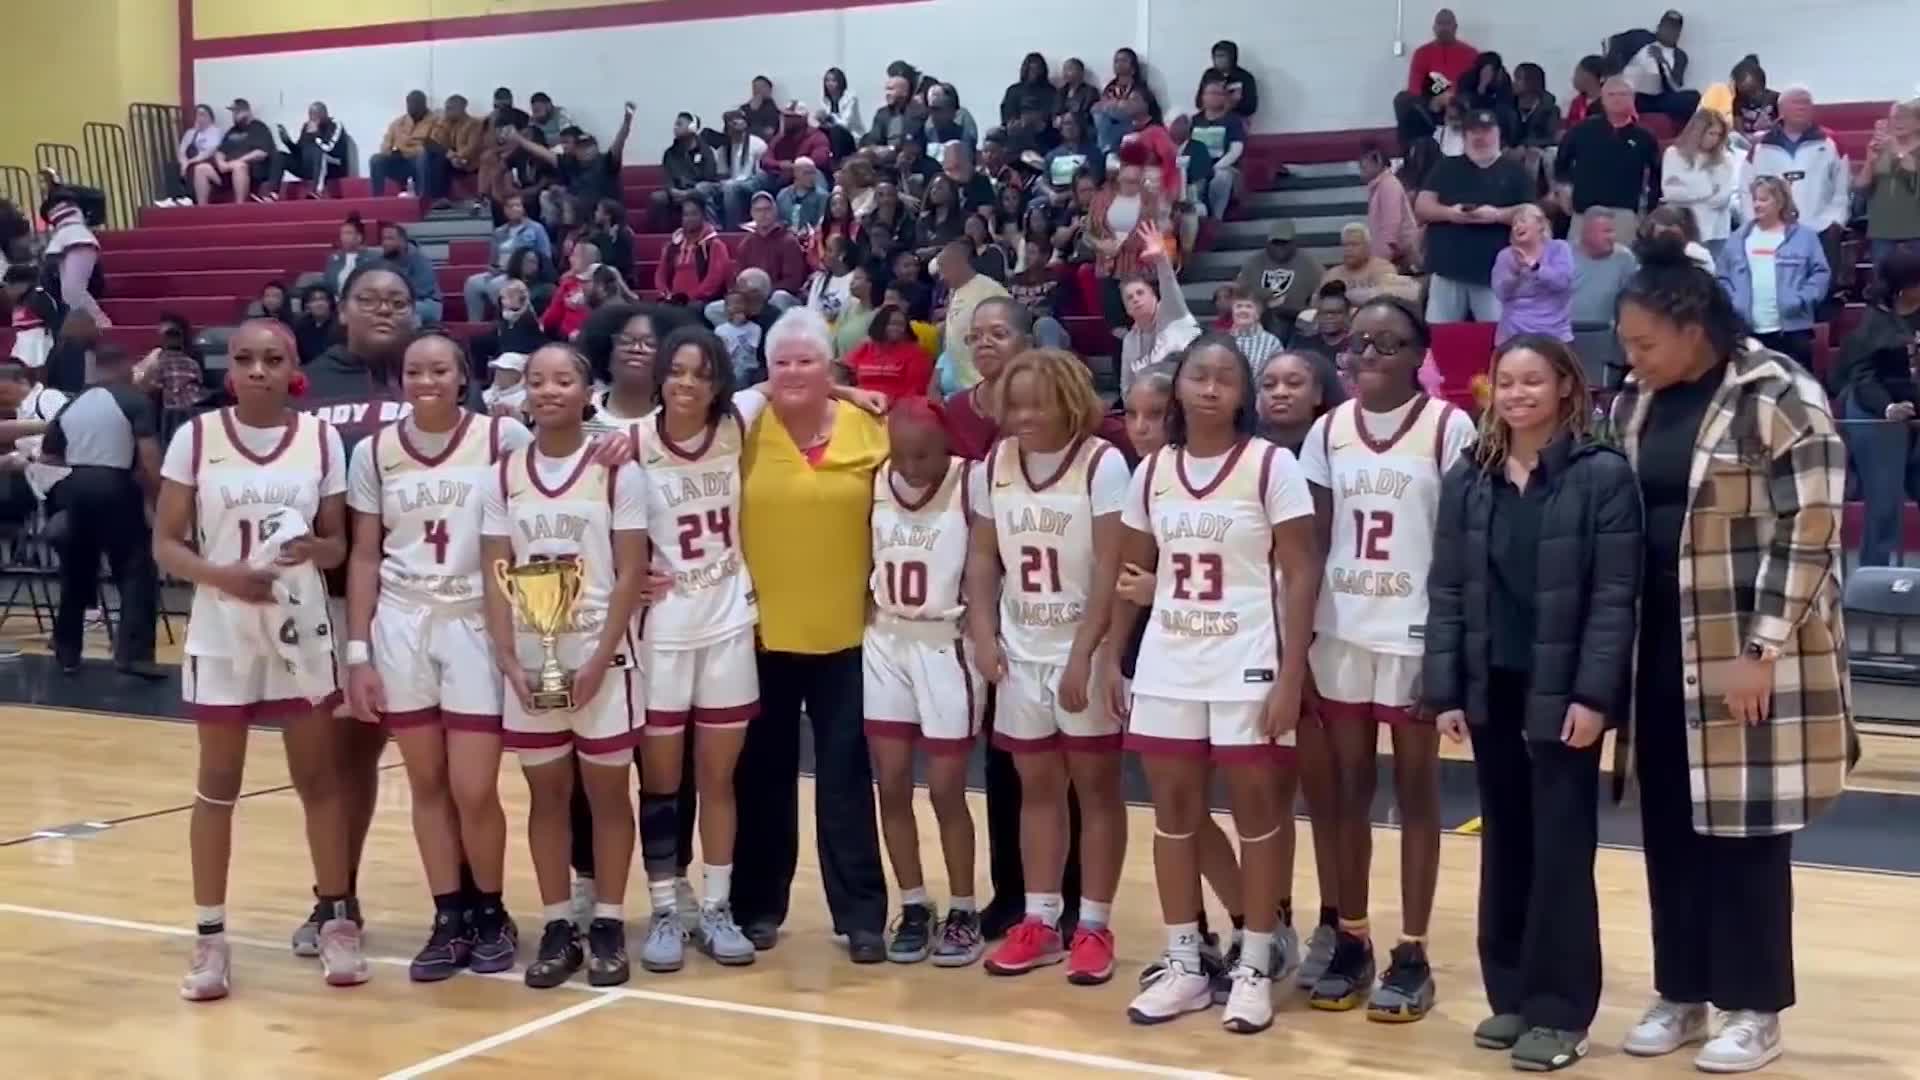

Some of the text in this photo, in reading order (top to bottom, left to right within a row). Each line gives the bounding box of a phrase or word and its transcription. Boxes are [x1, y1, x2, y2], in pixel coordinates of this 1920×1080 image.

[219, 482, 302, 510] LADY
[398, 479, 472, 513] LADY
[661, 471, 732, 508] LADY
[1338, 468, 1413, 500] LADY
[518, 513, 589, 543] LADY
[677, 506, 732, 561] 24
[877, 524, 943, 552] LADY
[1006, 507, 1073, 537] LADY
[1160, 511, 1233, 543] LADY
[1352, 509, 1394, 561] 12
[423, 519, 450, 565] 4
[884, 561, 929, 606] 10
[1020, 546, 1062, 593] 21
[1171, 552, 1223, 601] 23
